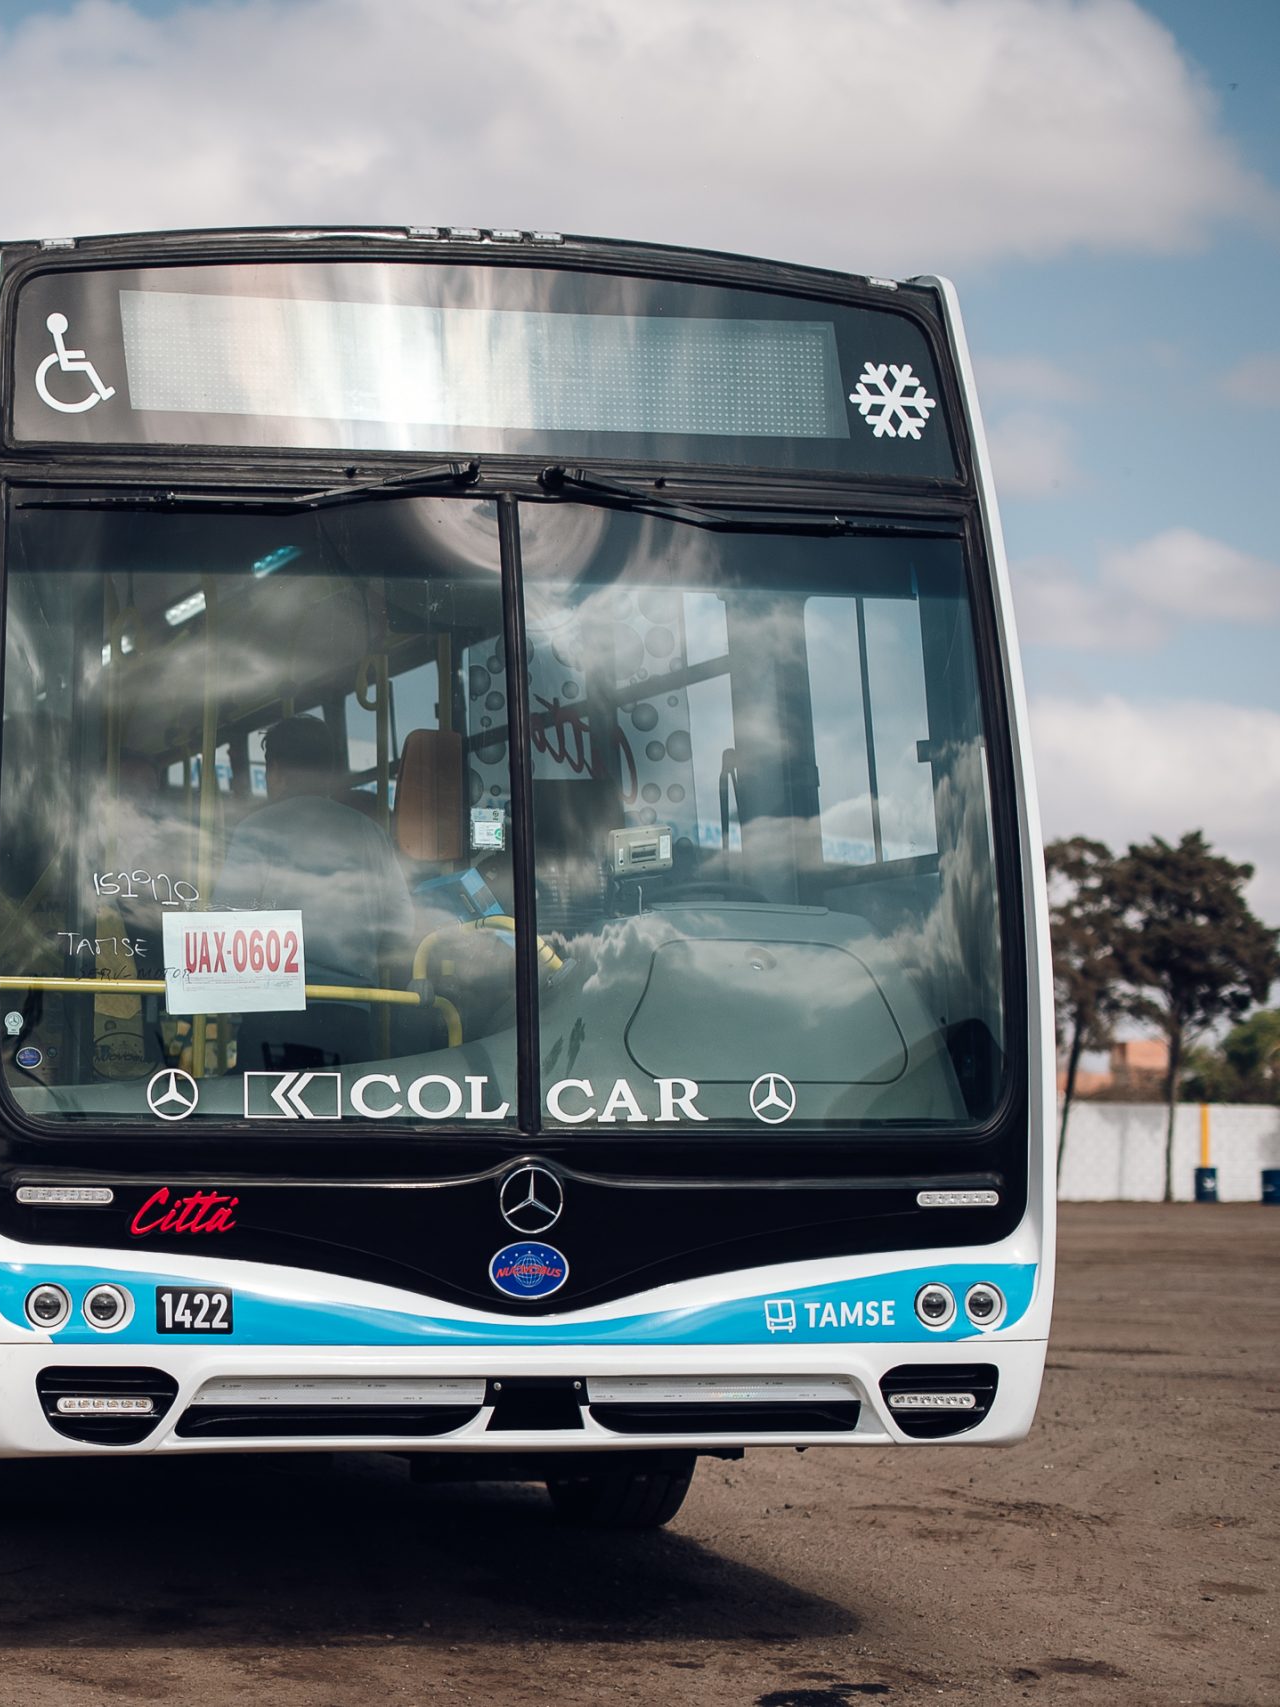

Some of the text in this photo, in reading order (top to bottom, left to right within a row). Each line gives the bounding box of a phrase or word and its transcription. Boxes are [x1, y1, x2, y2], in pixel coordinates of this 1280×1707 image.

[57, 932, 149, 958] TAMSE
[184, 929, 299, 974] UAX-0602
[350, 1074, 710, 1124] COL CAR
[496, 1263, 563, 1279] NUOVOBUS
[161, 1293, 228, 1328] 1422
[804, 1300, 896, 1328] TAMSE
